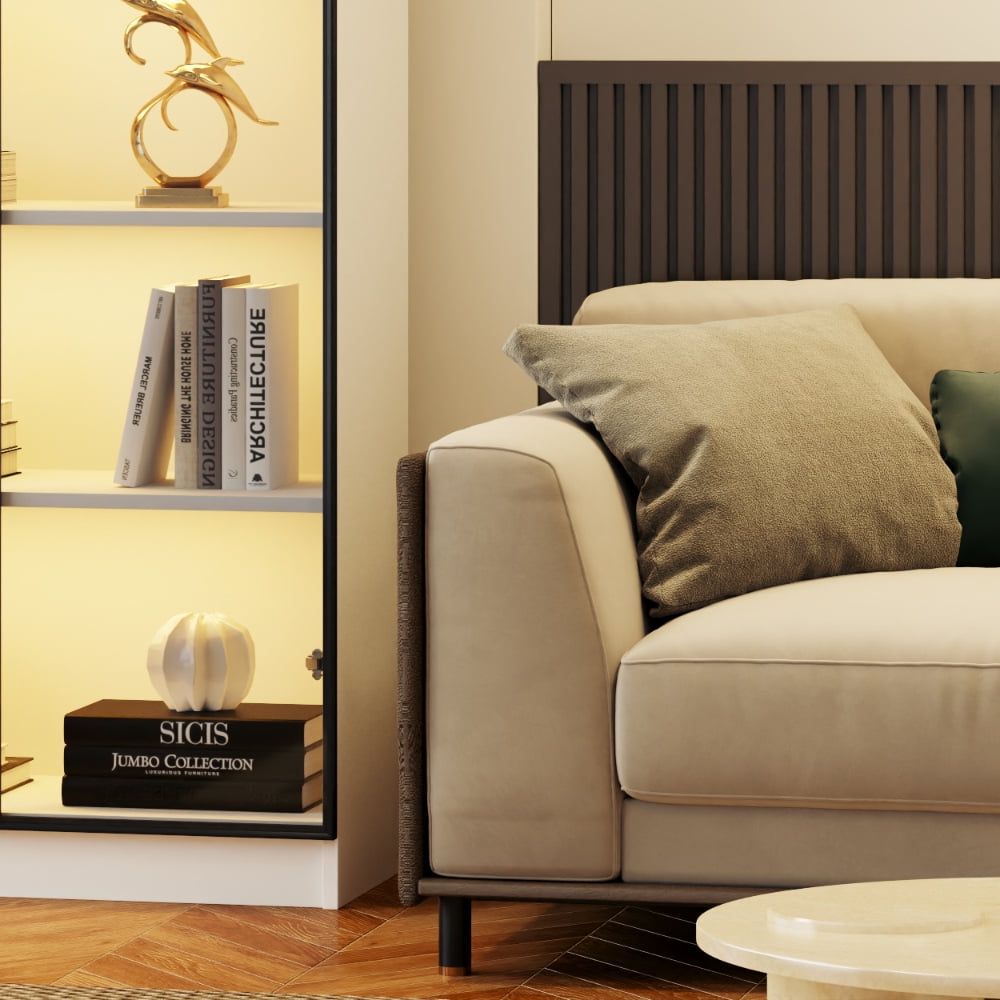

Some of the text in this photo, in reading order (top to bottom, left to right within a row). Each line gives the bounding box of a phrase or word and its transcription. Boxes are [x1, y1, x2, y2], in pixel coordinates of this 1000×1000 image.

[159, 720, 229, 746] SICIS
[111, 752, 254, 771] JUMBO COLLECTION
